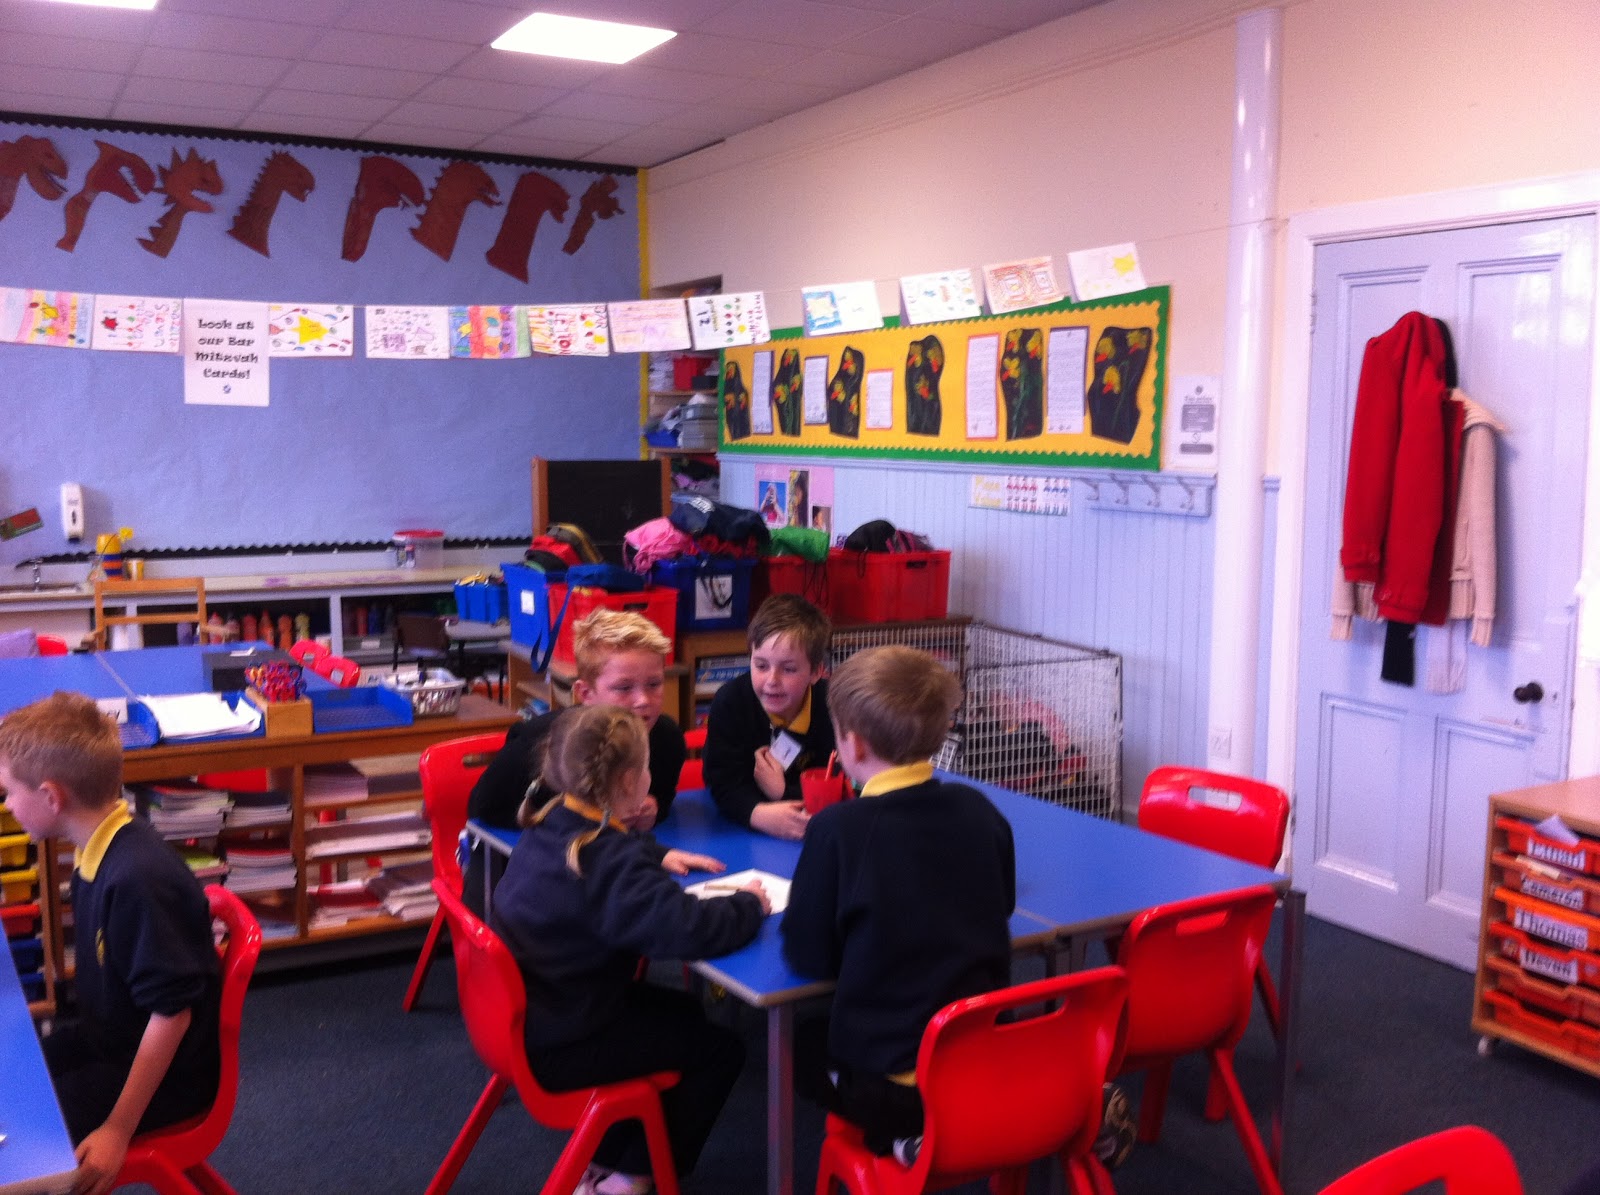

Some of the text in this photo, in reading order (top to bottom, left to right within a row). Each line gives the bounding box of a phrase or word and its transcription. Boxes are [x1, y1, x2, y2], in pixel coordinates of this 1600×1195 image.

[198, 318, 255, 330] Look at
[198, 337, 255, 347] our Bar
[203, 368, 251, 380] Cards!
[1515, 907, 1587, 950] Thomas
